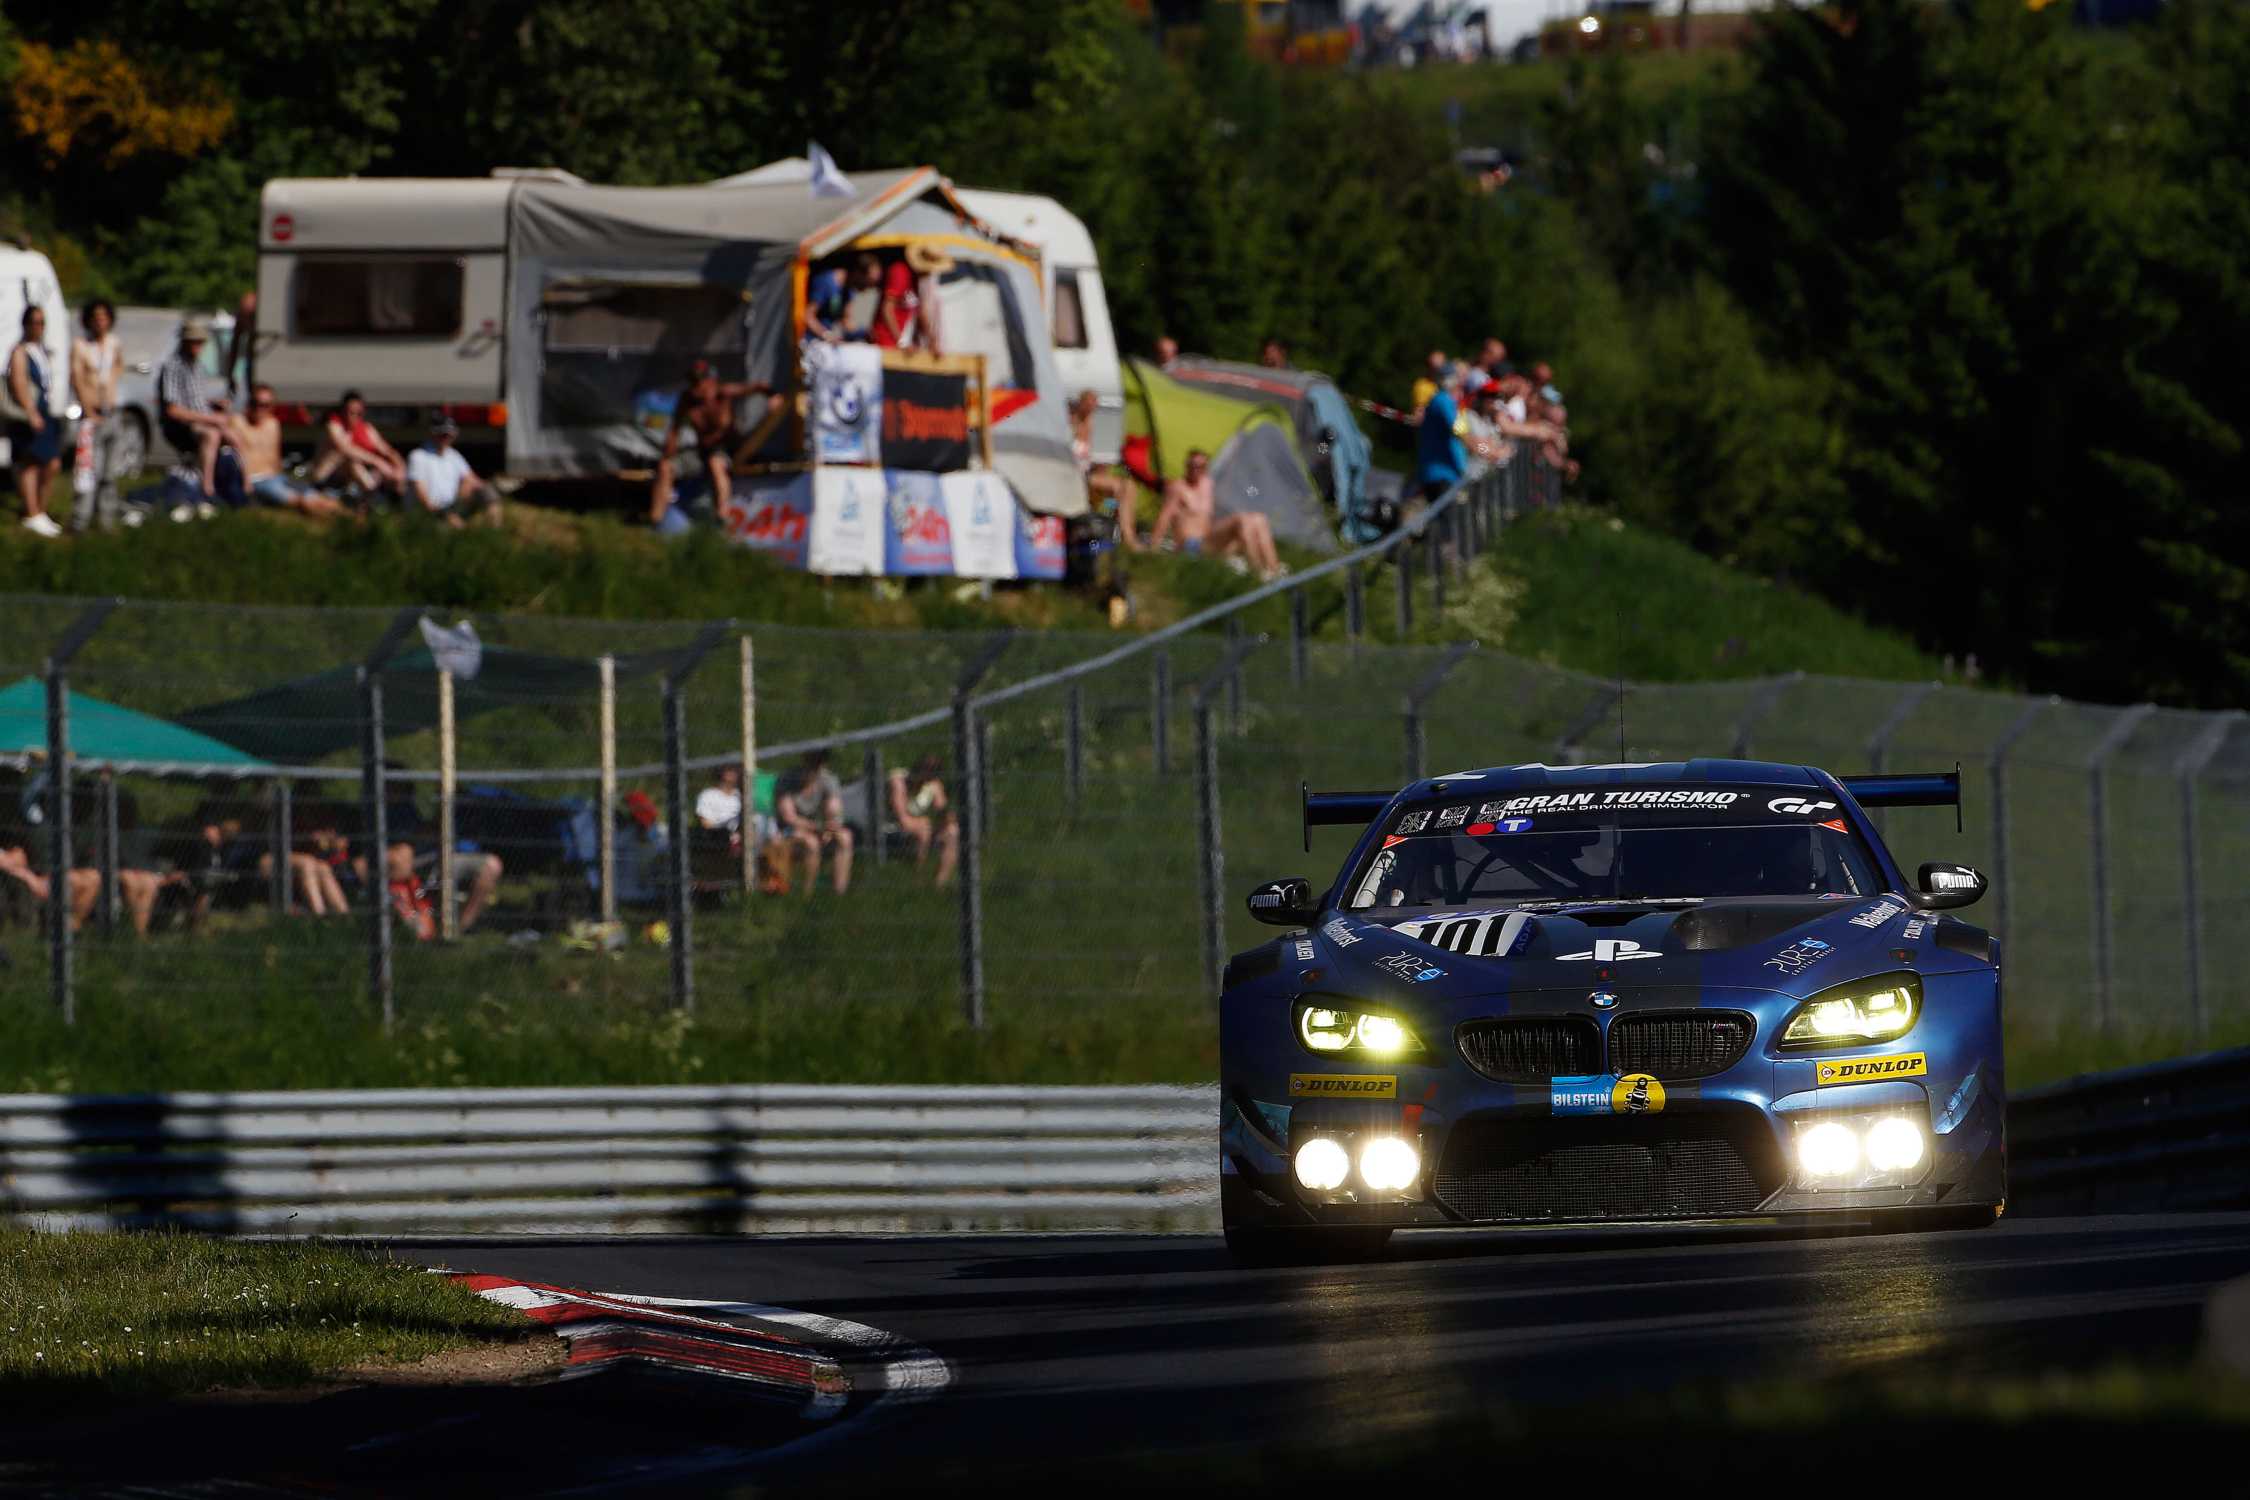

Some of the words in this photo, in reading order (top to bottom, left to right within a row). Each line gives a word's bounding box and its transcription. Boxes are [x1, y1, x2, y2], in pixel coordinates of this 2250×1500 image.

[1508, 792, 1595, 809] GRAN
[1603, 790, 1739, 805] TURISMO
[1506, 808, 1536, 816] THE
[1537, 805, 1575, 815] REAL
[1578, 802, 1640, 811] DRIVING
[1642, 802, 1729, 810] SIMULATOR
[1938, 874, 1975, 889] PUMA
[1249, 893, 1281, 909] PUMA
[1838, 1058, 1923, 1077] DUNLOP
[1308, 1079, 1393, 1092] DUNLOP
[1553, 1093, 1609, 1107] BILSTEIN
